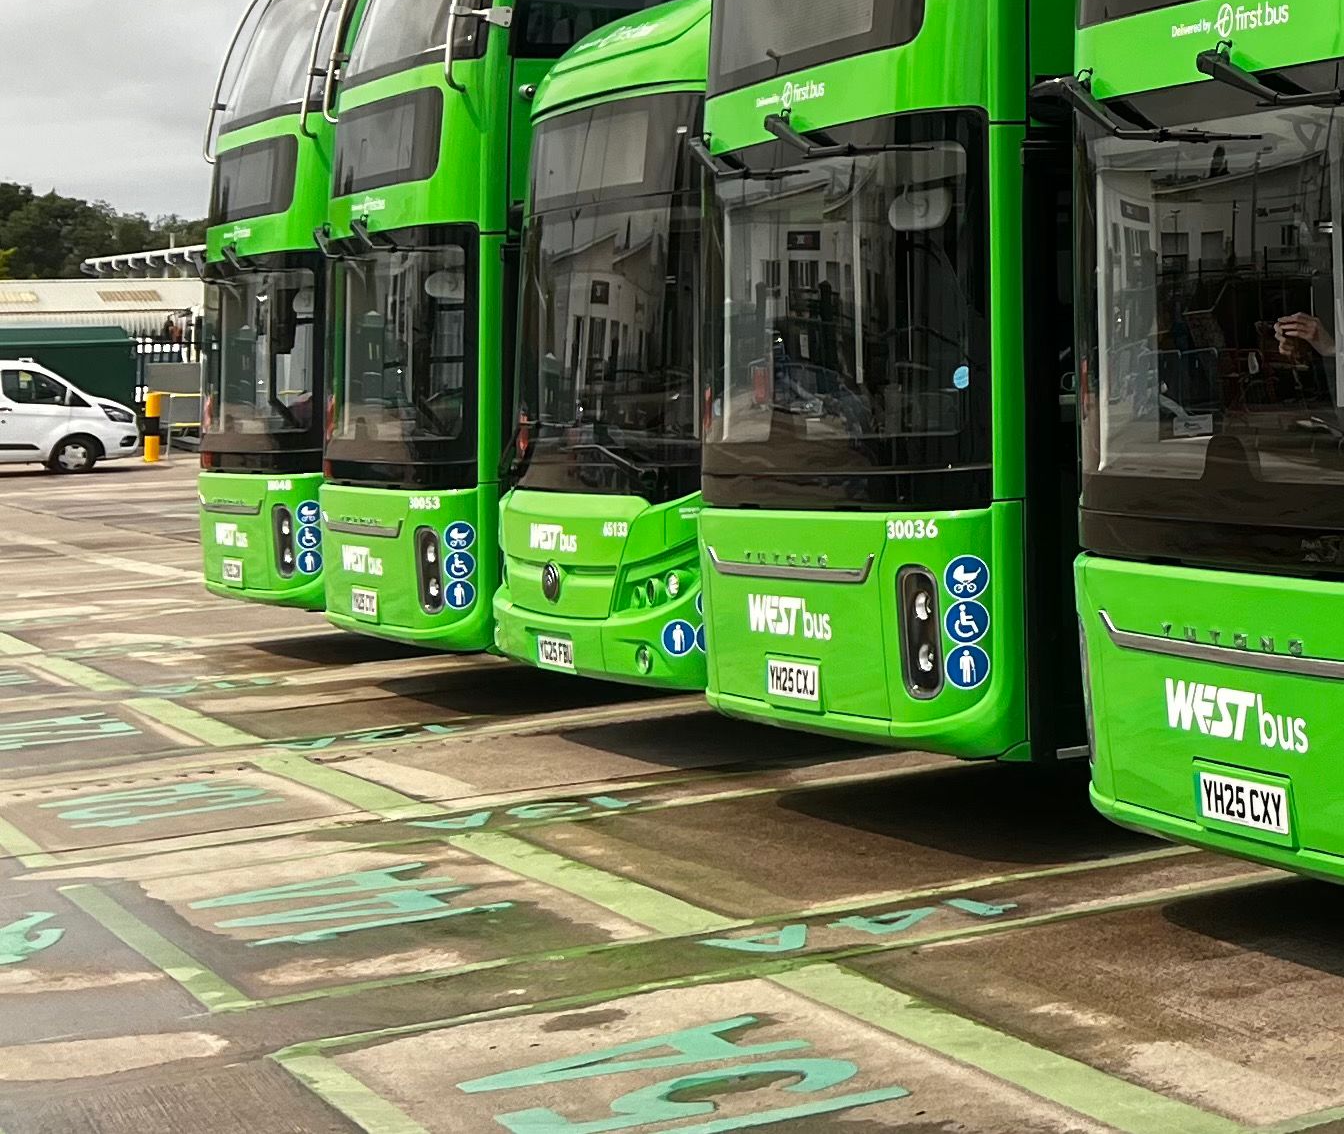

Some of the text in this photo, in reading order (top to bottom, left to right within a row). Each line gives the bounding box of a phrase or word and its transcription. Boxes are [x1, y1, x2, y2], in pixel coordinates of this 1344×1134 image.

[1171, 18, 1212, 38] Delivered by
[1236, 1, 1289, 31] first bus
[811, 80, 825, 99] bus
[561, 531, 577, 553] bus
[886, 519, 939, 539] 30036
[748, 594, 832, 641] WEST bus
[769, 665, 816, 696] YH25 CXJ
[1165, 677, 1309, 754] WEST bus
[1202, 778, 1282, 827] YH25 CXY
